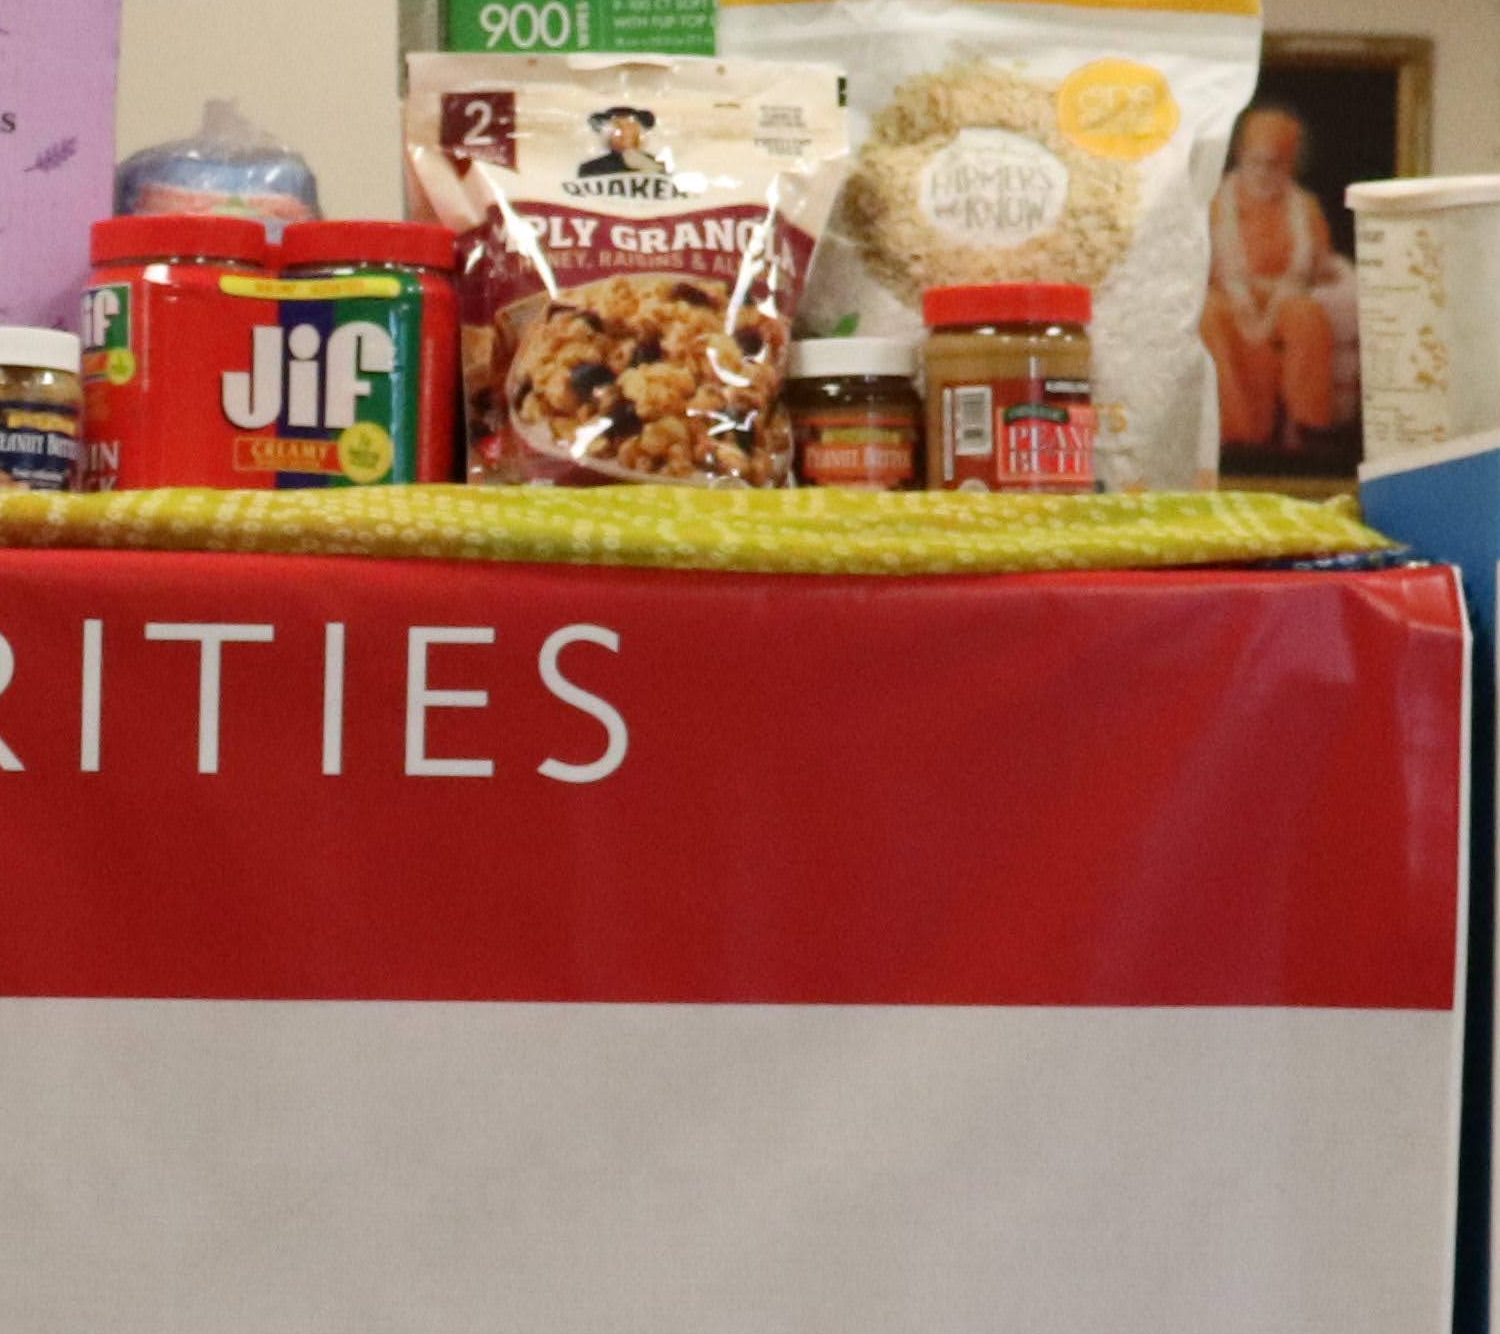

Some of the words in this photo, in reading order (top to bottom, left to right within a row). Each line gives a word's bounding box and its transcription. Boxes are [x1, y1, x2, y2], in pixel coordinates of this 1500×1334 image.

[478, 0, 571, 50] 900
[462, 99, 494, 146] 2
[220, 320, 397, 430] Jif
